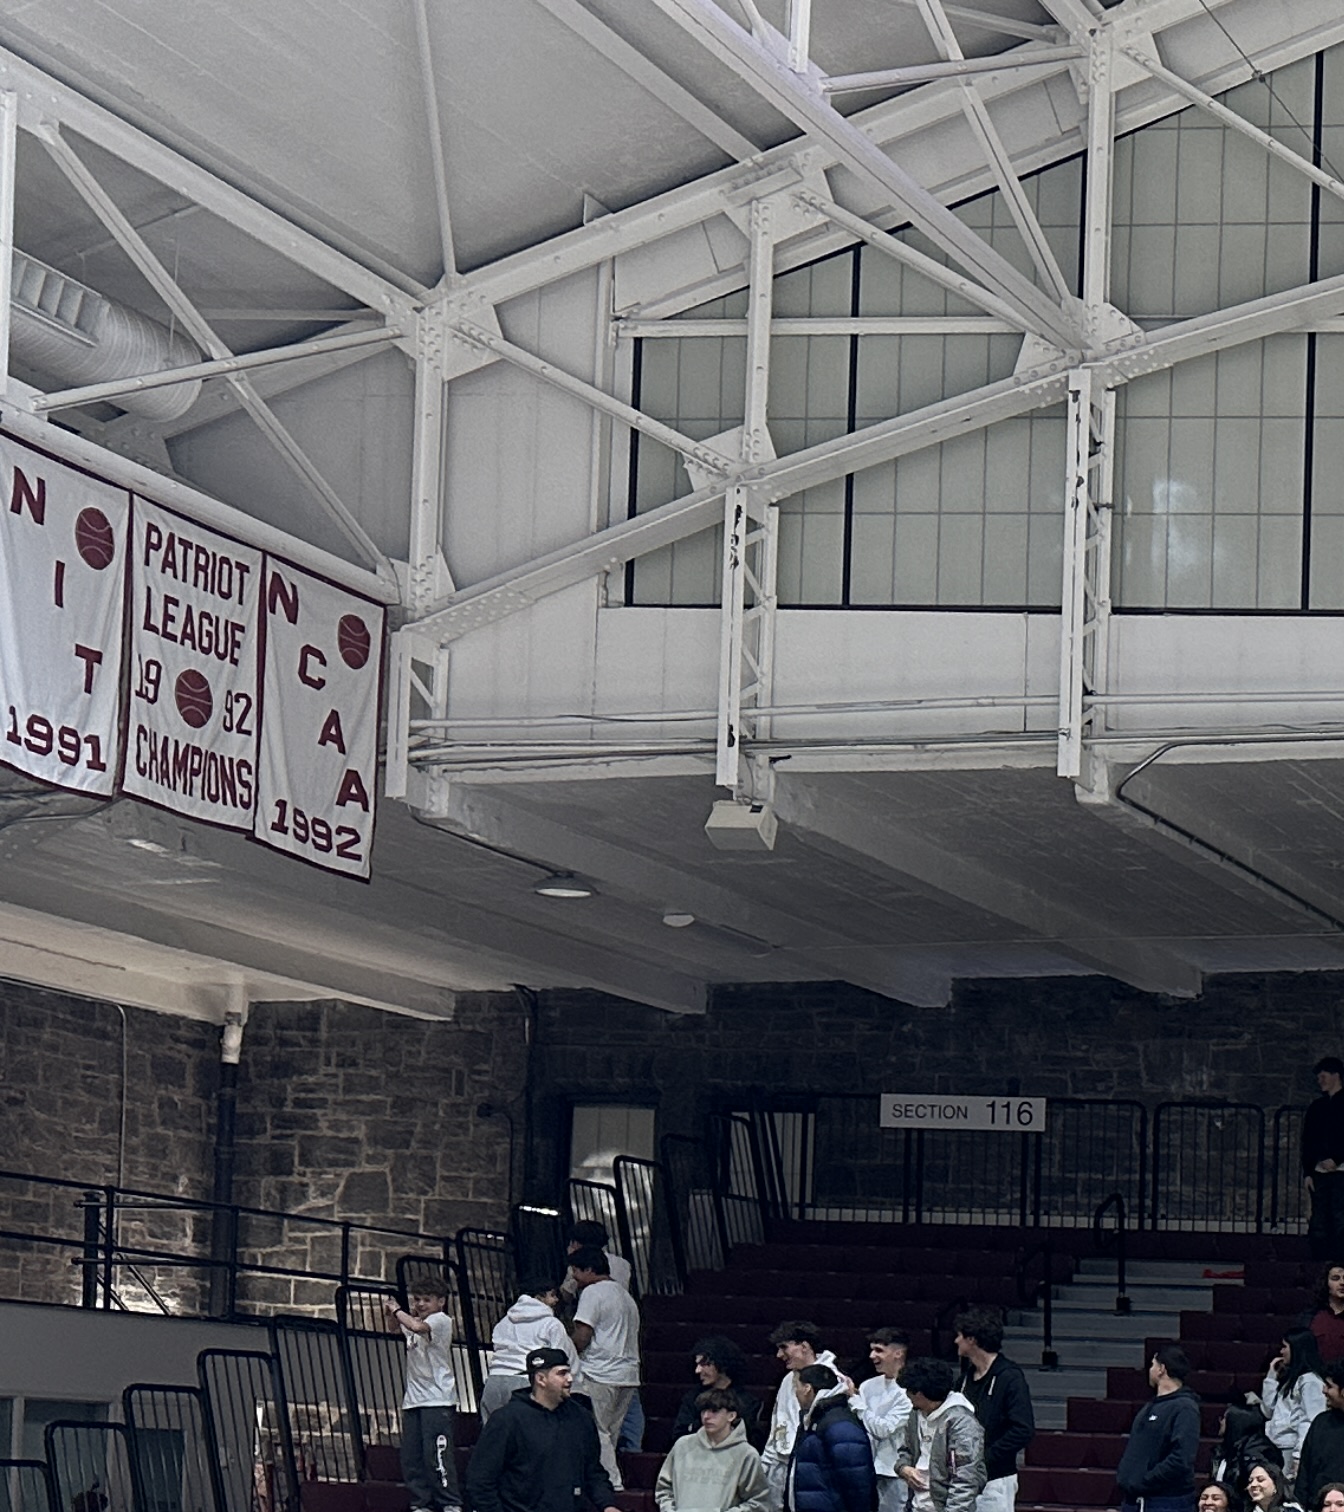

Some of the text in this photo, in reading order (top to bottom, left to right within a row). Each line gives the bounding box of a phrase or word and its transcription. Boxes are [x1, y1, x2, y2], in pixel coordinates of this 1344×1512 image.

[145, 522, 250, 606] PATRIOT
[144, 587, 245, 666] LEAGUE
[135, 654, 252, 736] 19 92
[7, 706, 106, 772] 1991
[136, 724, 252, 810] CHAMPIONS
[271, 799, 362, 861] 1992
[892, 1101, 1033, 1125] SECTION 116
